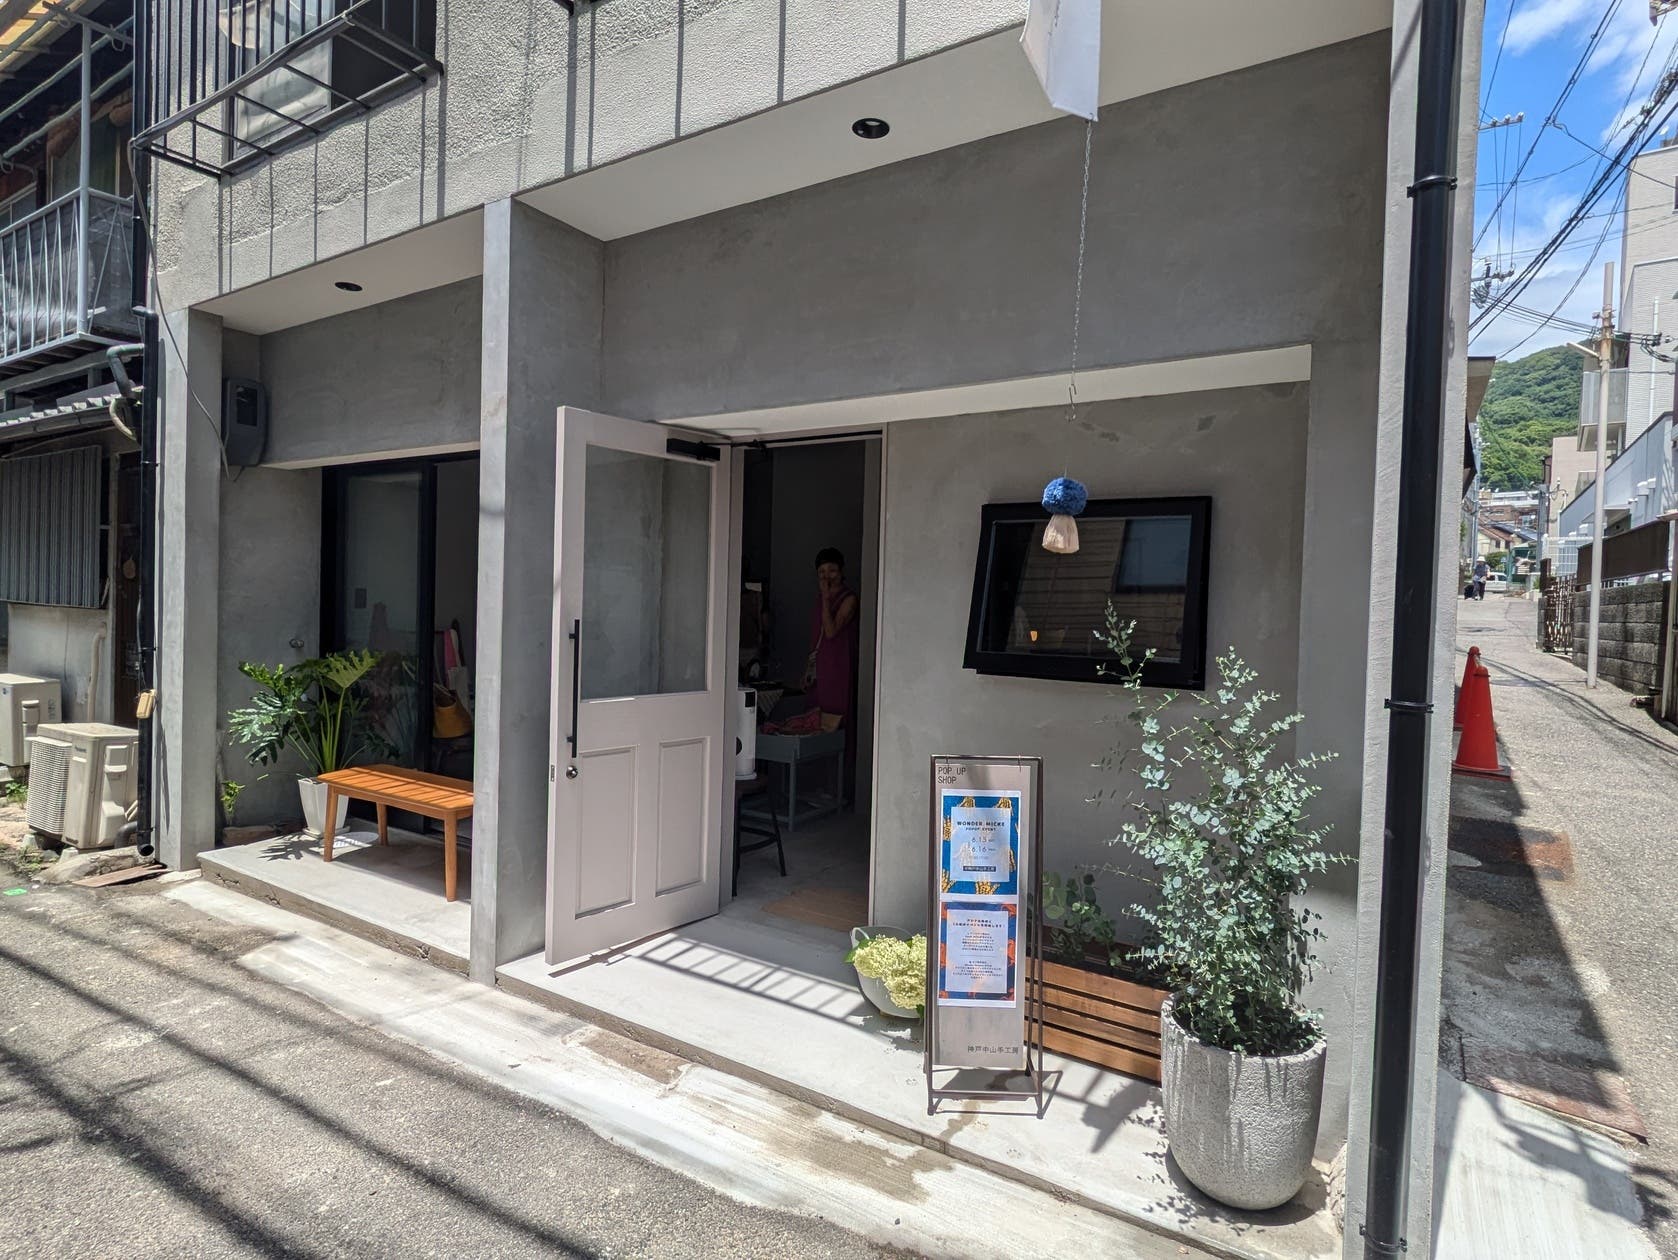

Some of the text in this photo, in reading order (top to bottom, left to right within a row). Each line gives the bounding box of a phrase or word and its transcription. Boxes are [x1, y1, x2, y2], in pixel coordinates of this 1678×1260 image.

[938, 766, 967, 776] POP UP
[937, 776, 957, 785] SHOP
